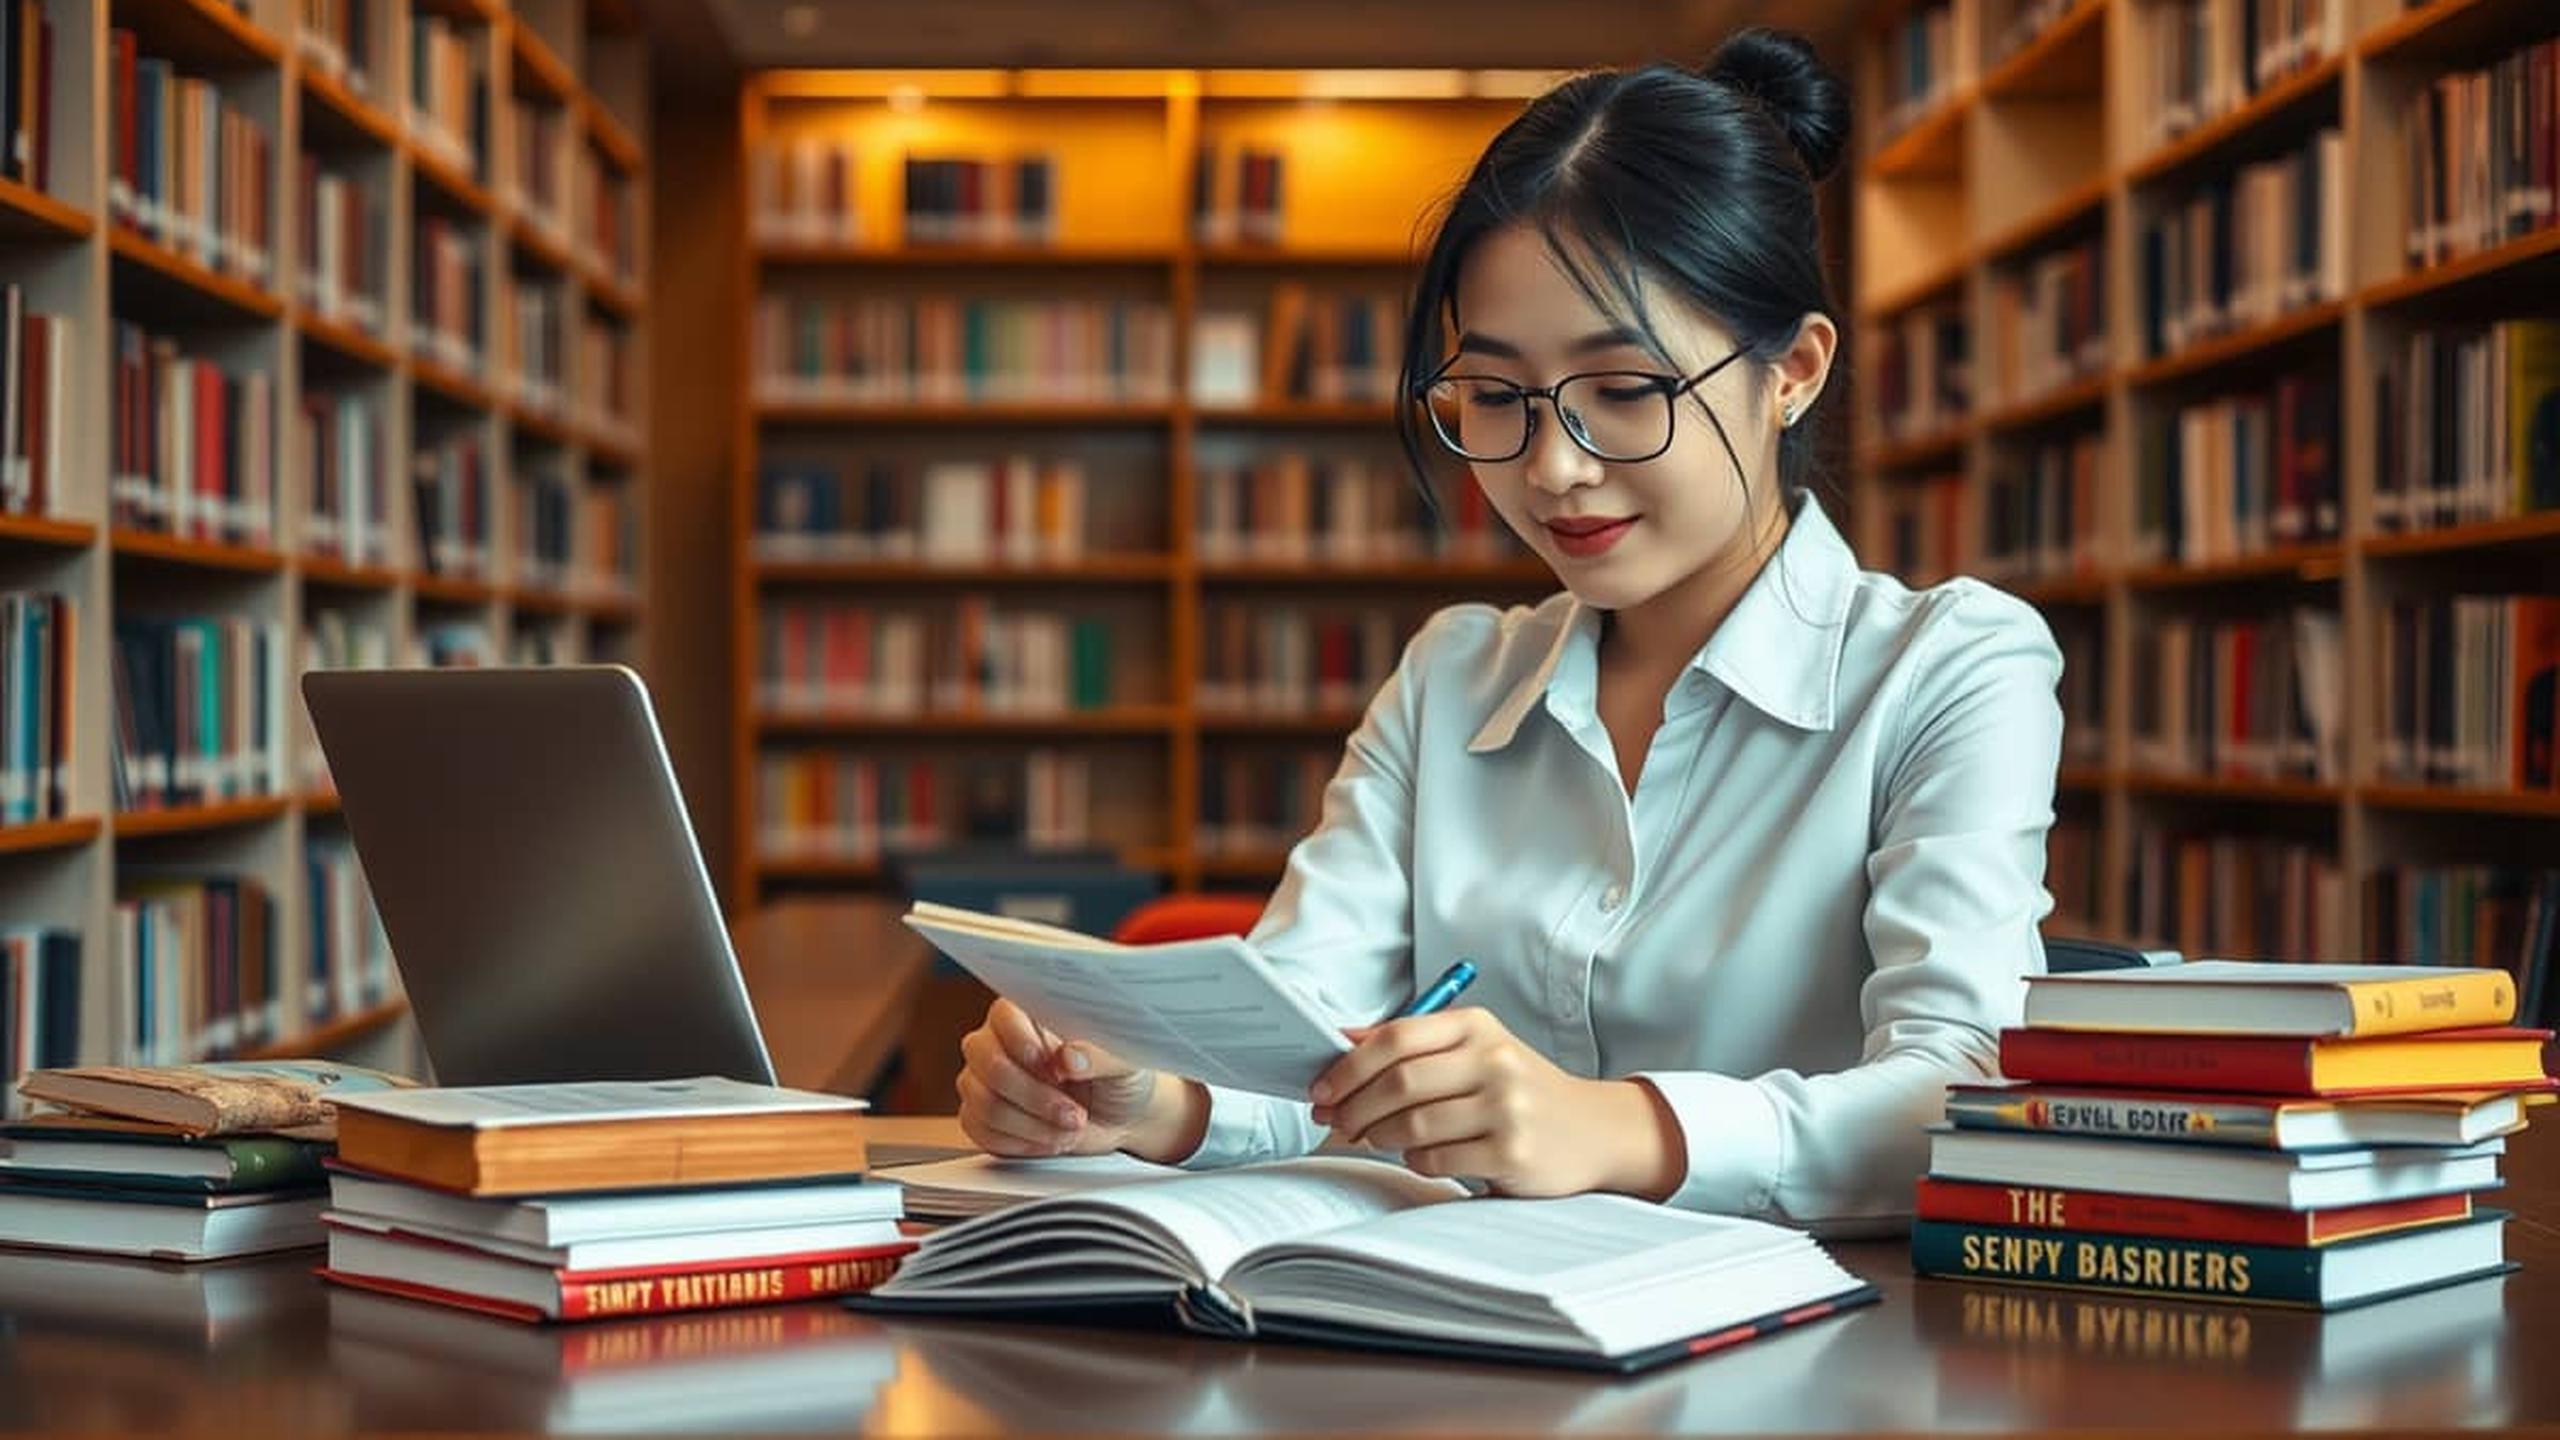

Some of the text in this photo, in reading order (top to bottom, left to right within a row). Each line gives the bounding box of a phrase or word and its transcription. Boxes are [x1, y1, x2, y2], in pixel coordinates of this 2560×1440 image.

[2006, 1189, 2066, 1226] THE
[1963, 1234, 2250, 1292] SENPY BASRIERS
